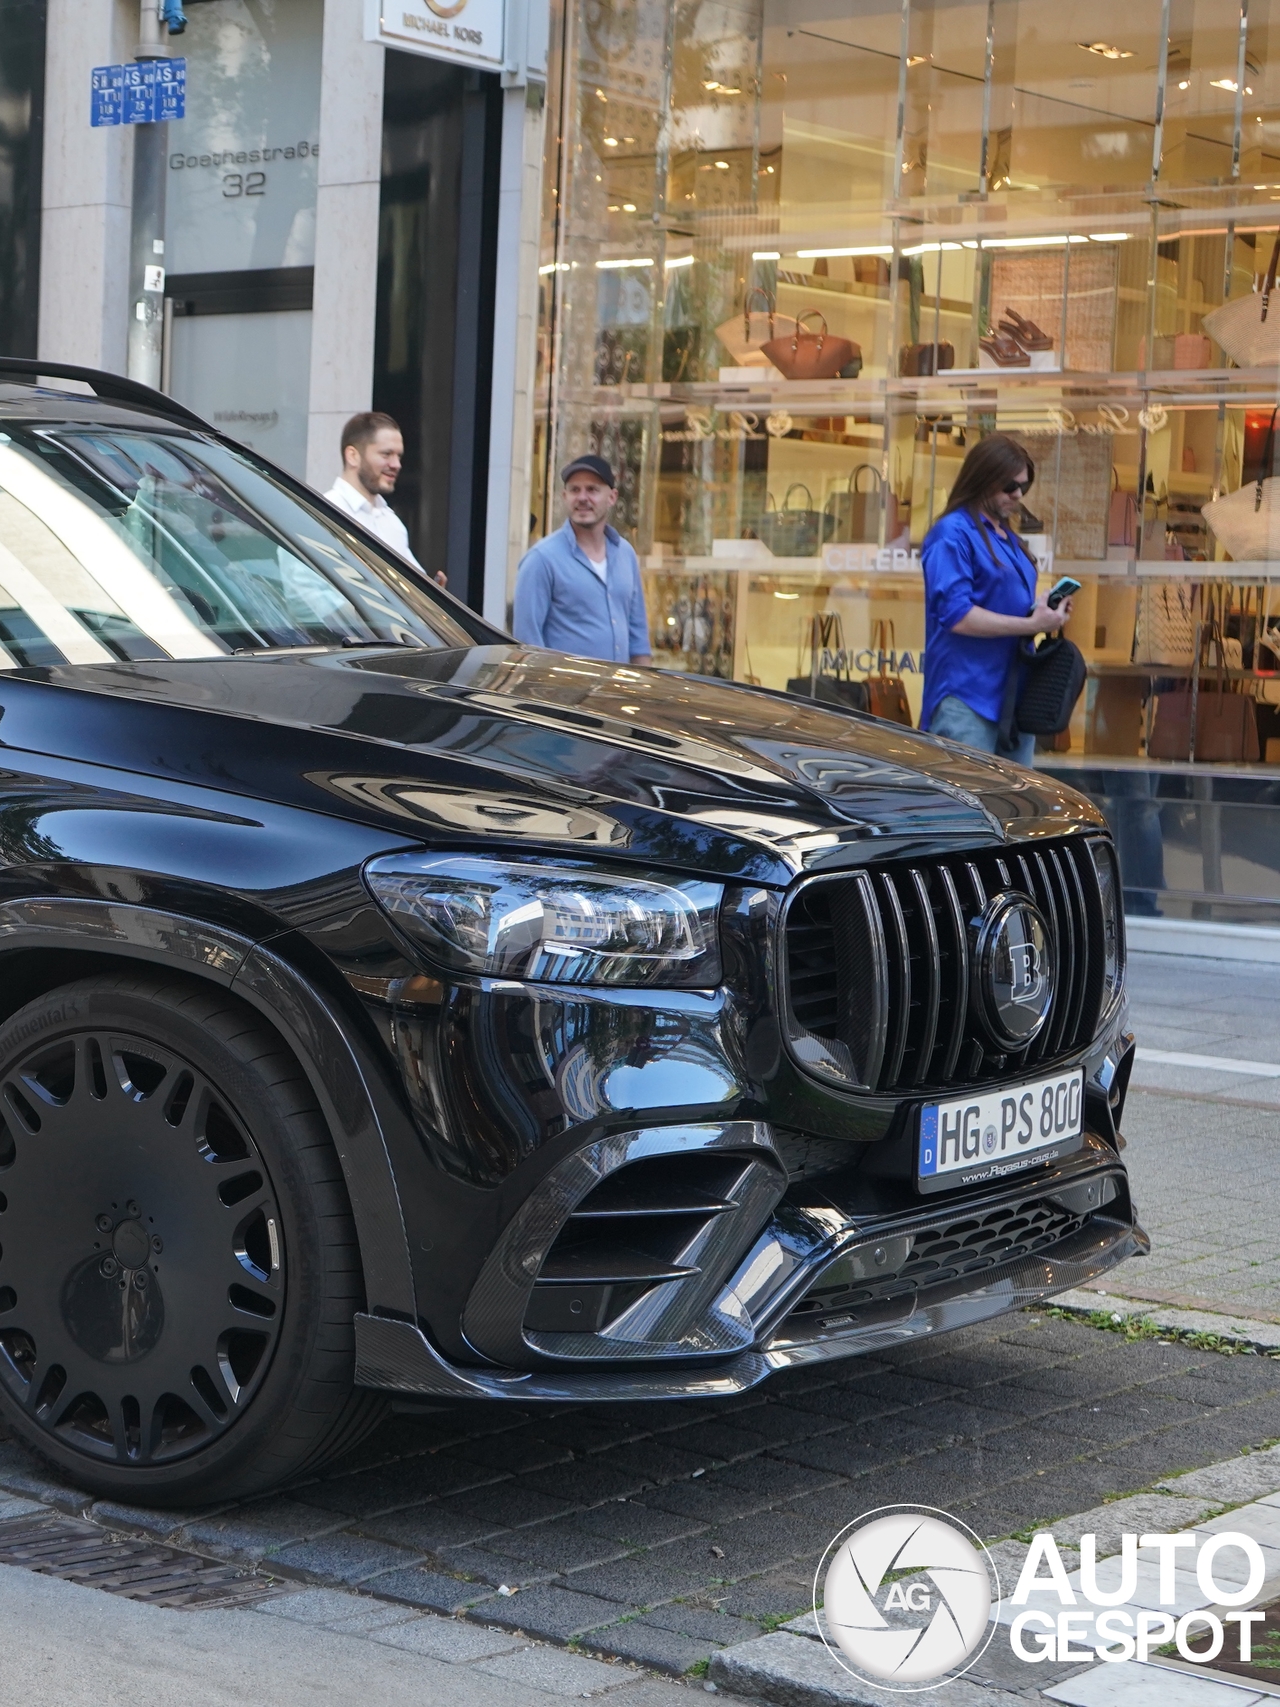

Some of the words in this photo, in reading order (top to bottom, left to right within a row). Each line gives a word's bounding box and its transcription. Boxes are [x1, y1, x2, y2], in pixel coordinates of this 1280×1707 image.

[402, 12, 450, 38] MICHAEL
[453, 25, 483, 45] KORS
[169, 140, 319, 170] Goethestraße
[222, 171, 266, 198] 32
[940, 1105, 981, 1165] HG
[1001, 1092, 1034, 1150] PS
[1040, 1078, 1080, 1138] 800
[924, 1149, 933, 1165] D
